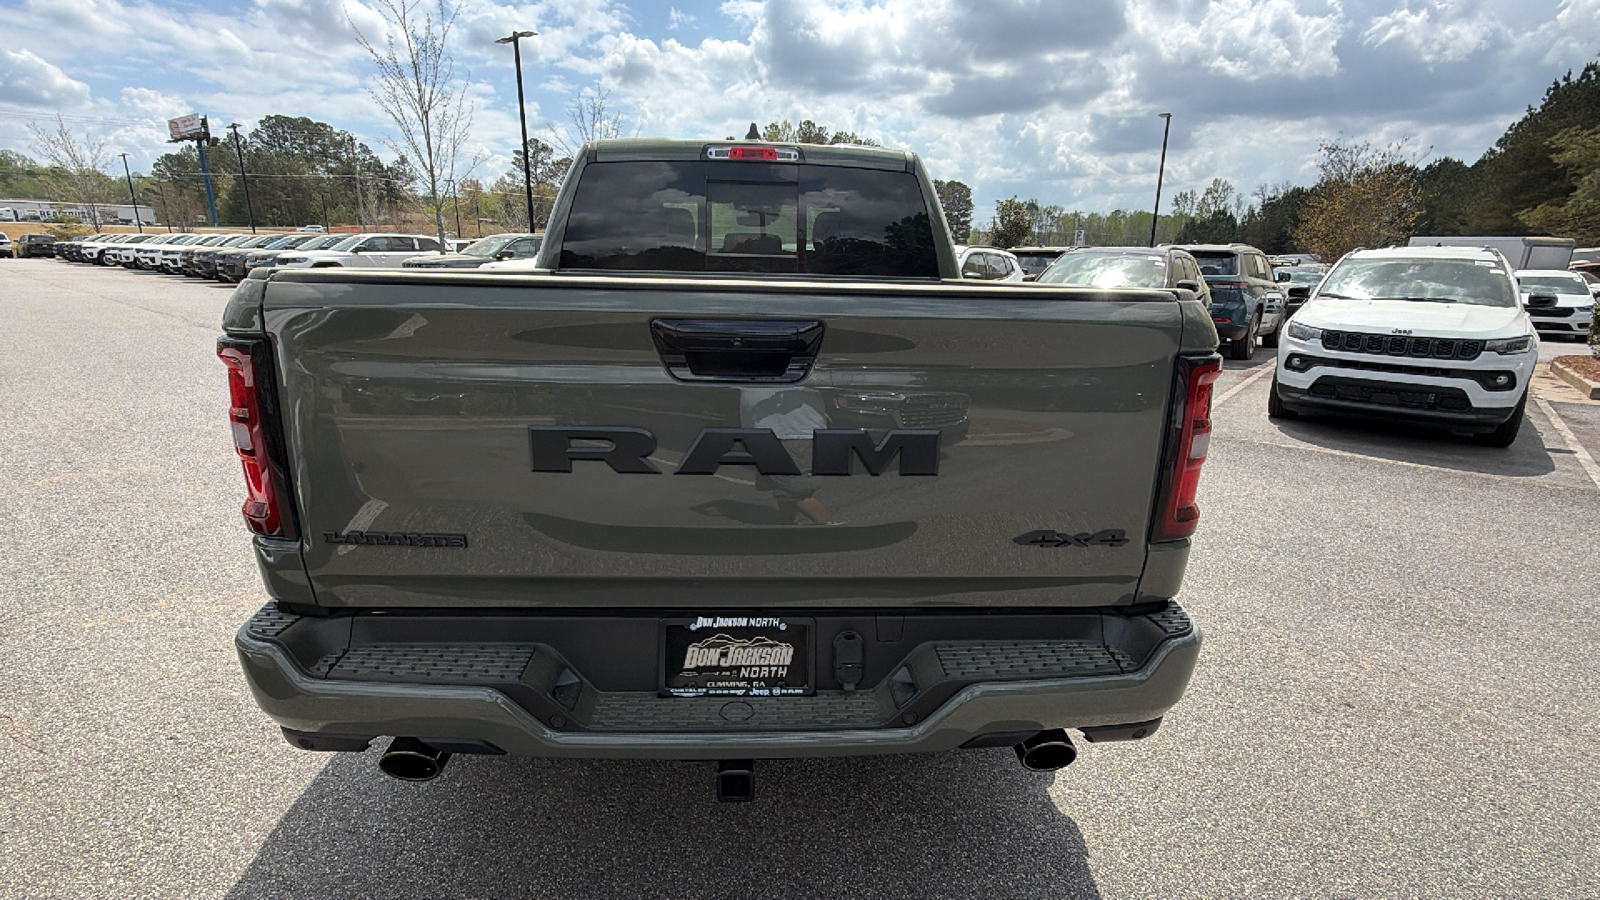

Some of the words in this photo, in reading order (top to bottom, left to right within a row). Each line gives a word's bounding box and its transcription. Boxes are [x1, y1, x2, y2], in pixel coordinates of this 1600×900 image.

[1391, 327, 1413, 335] Jeep
[528, 424, 941, 477] RAM
[323, 530, 468, 549] LARAMIE
[748, 617, 780, 627] NORTH
[739, 666, 788, 678] NORTH
[749, 687, 770, 696] Jeep
